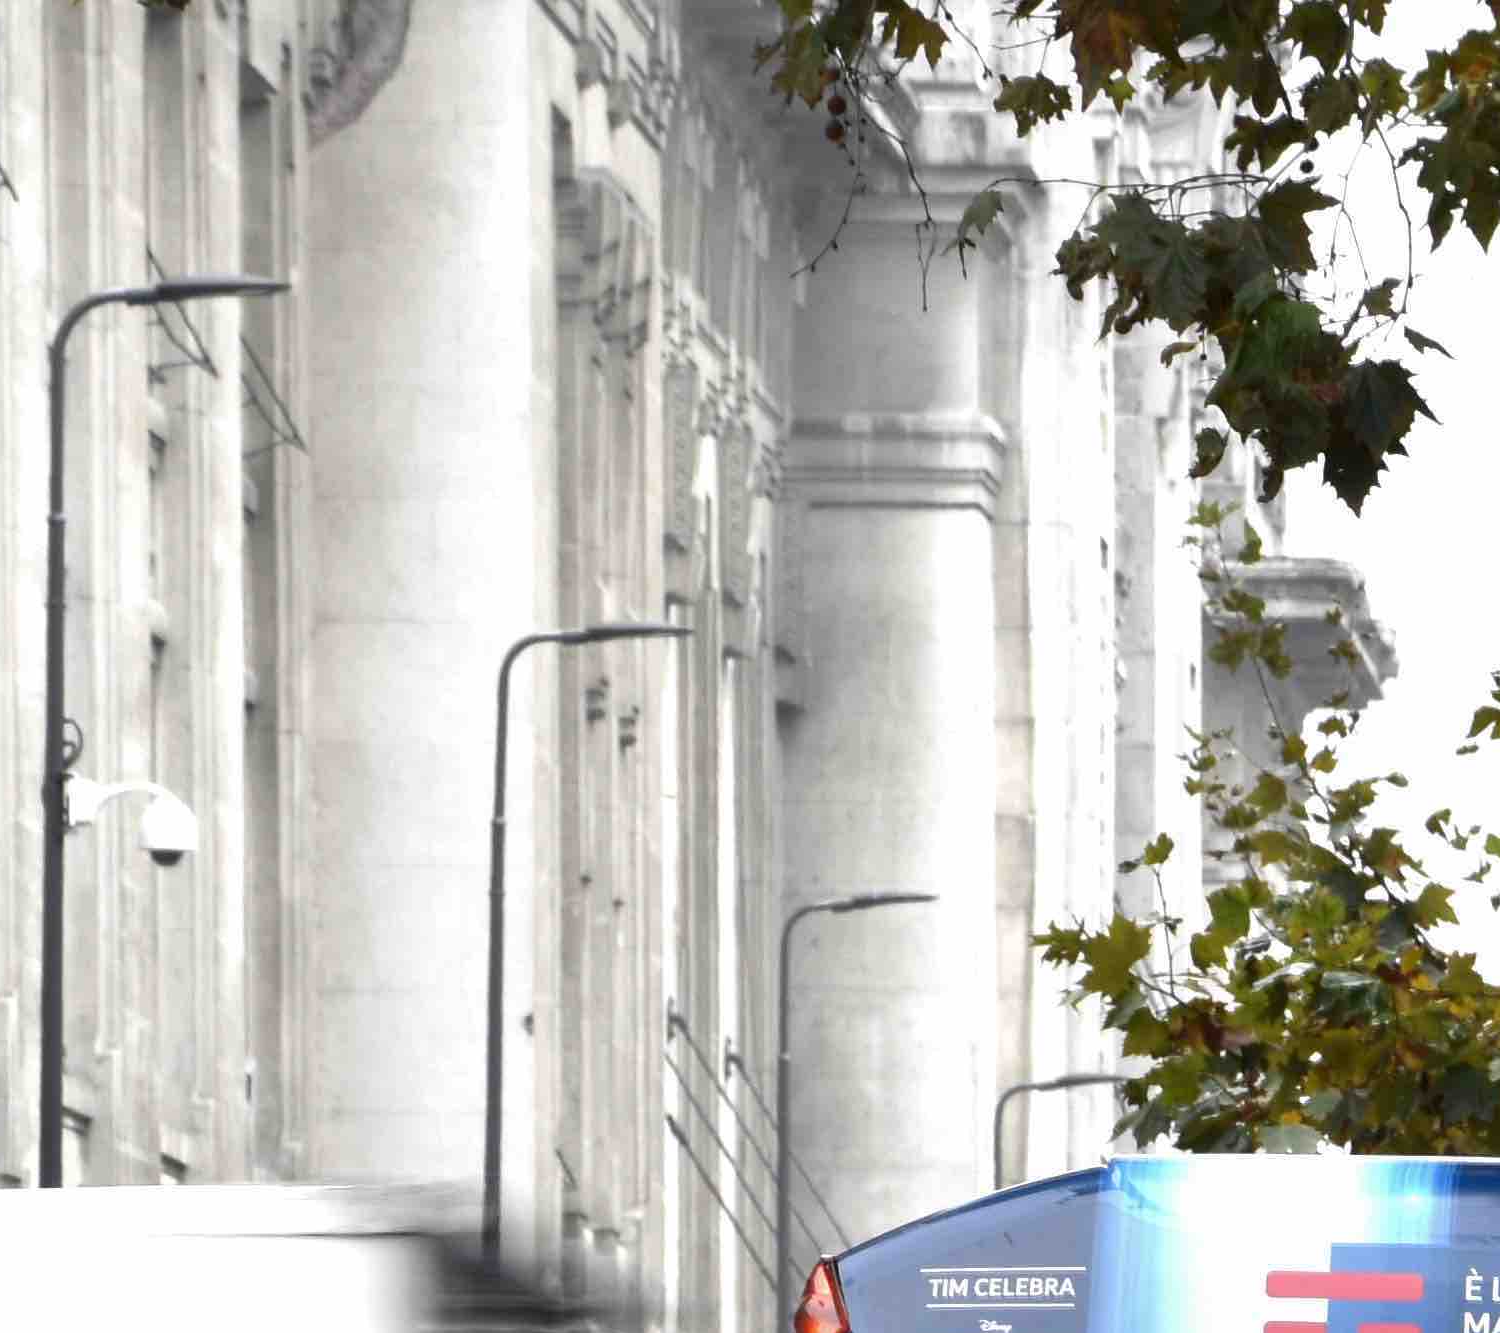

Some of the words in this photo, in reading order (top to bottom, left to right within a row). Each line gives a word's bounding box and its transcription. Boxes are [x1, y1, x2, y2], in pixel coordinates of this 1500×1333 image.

[929, 1278, 968, 1297] TIM
[974, 1277, 1075, 1298] CELEBRA
[1465, 1271, 1483, 1302] È
